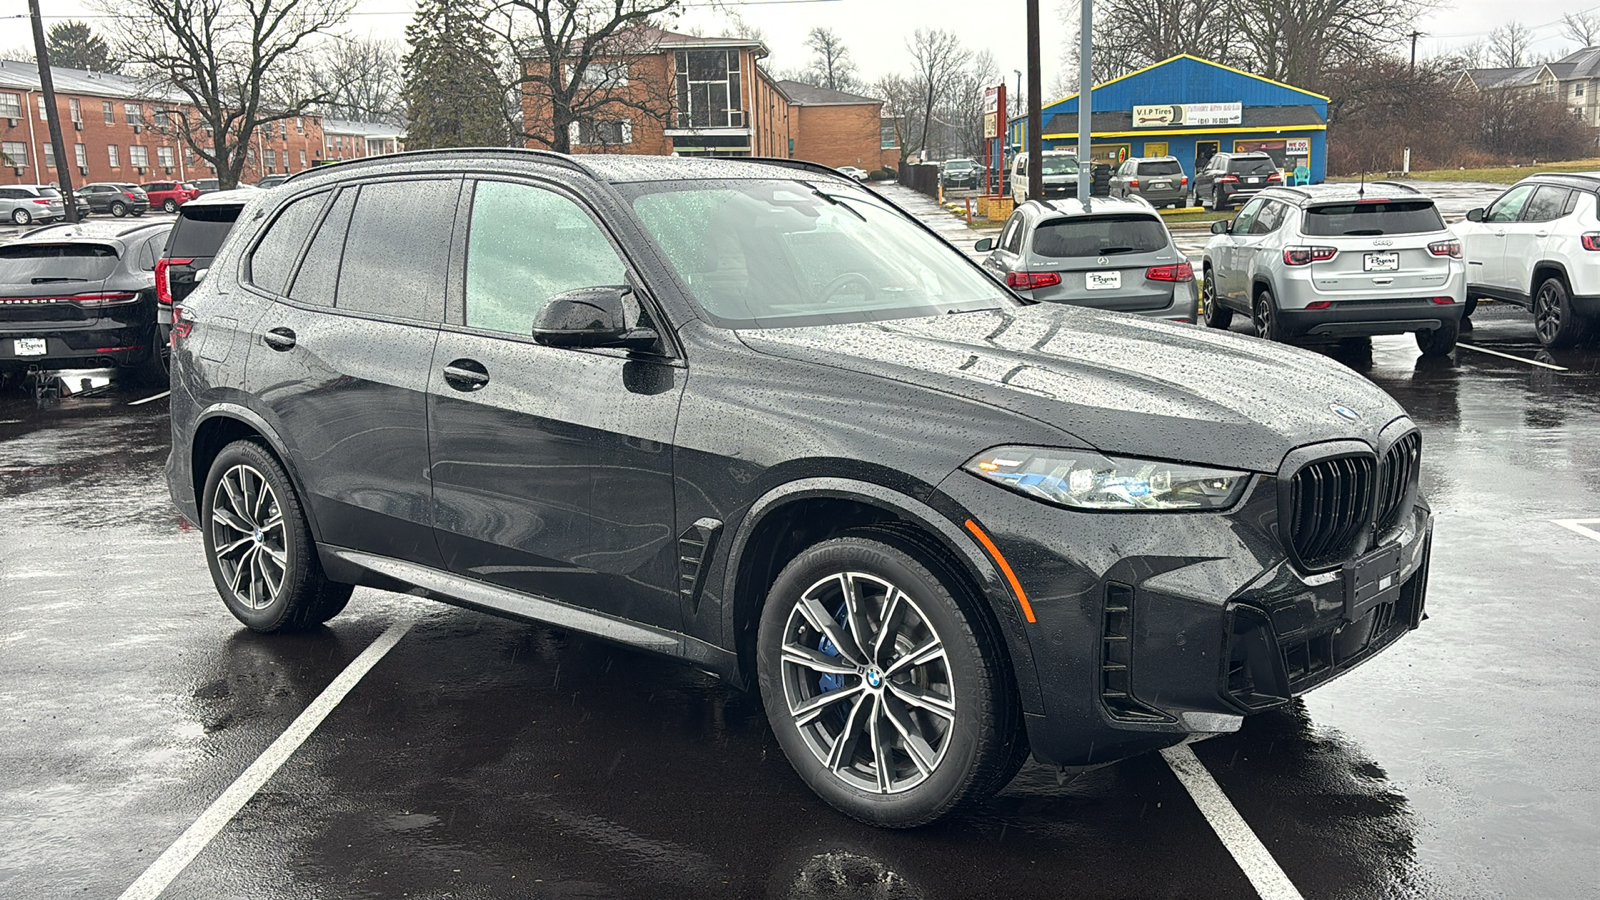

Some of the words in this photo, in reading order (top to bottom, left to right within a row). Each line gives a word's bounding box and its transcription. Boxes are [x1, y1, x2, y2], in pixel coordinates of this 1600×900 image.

[1136, 108, 1153, 116] V.I.P
[241, 447, 280, 490] BRIDGESTONE
[800, 546, 890, 567] BRIDGESTONE
